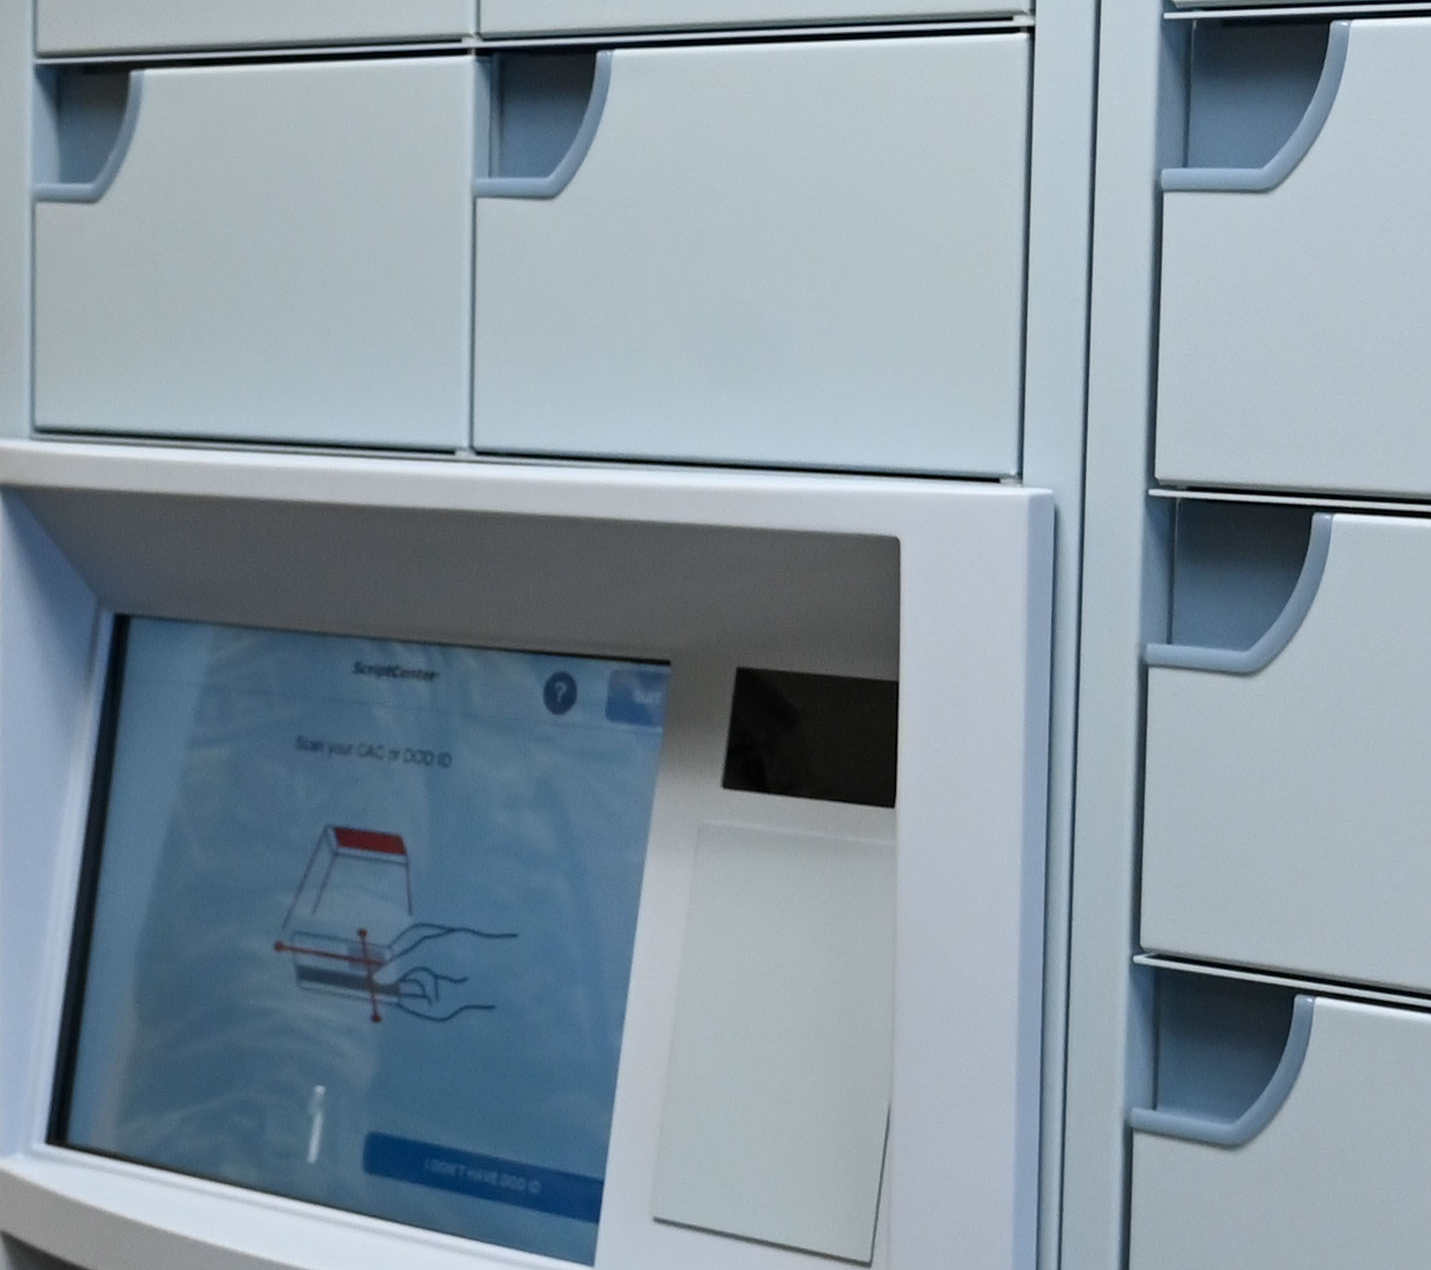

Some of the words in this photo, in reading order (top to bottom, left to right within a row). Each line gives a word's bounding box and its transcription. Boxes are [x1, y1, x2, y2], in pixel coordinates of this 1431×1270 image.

[294, 734, 325, 753] Scan
[327, 740, 354, 757] your
[356, 742, 385, 761] CAC
[386, 749, 401, 762] or
[436, 750, 454, 769] ID
